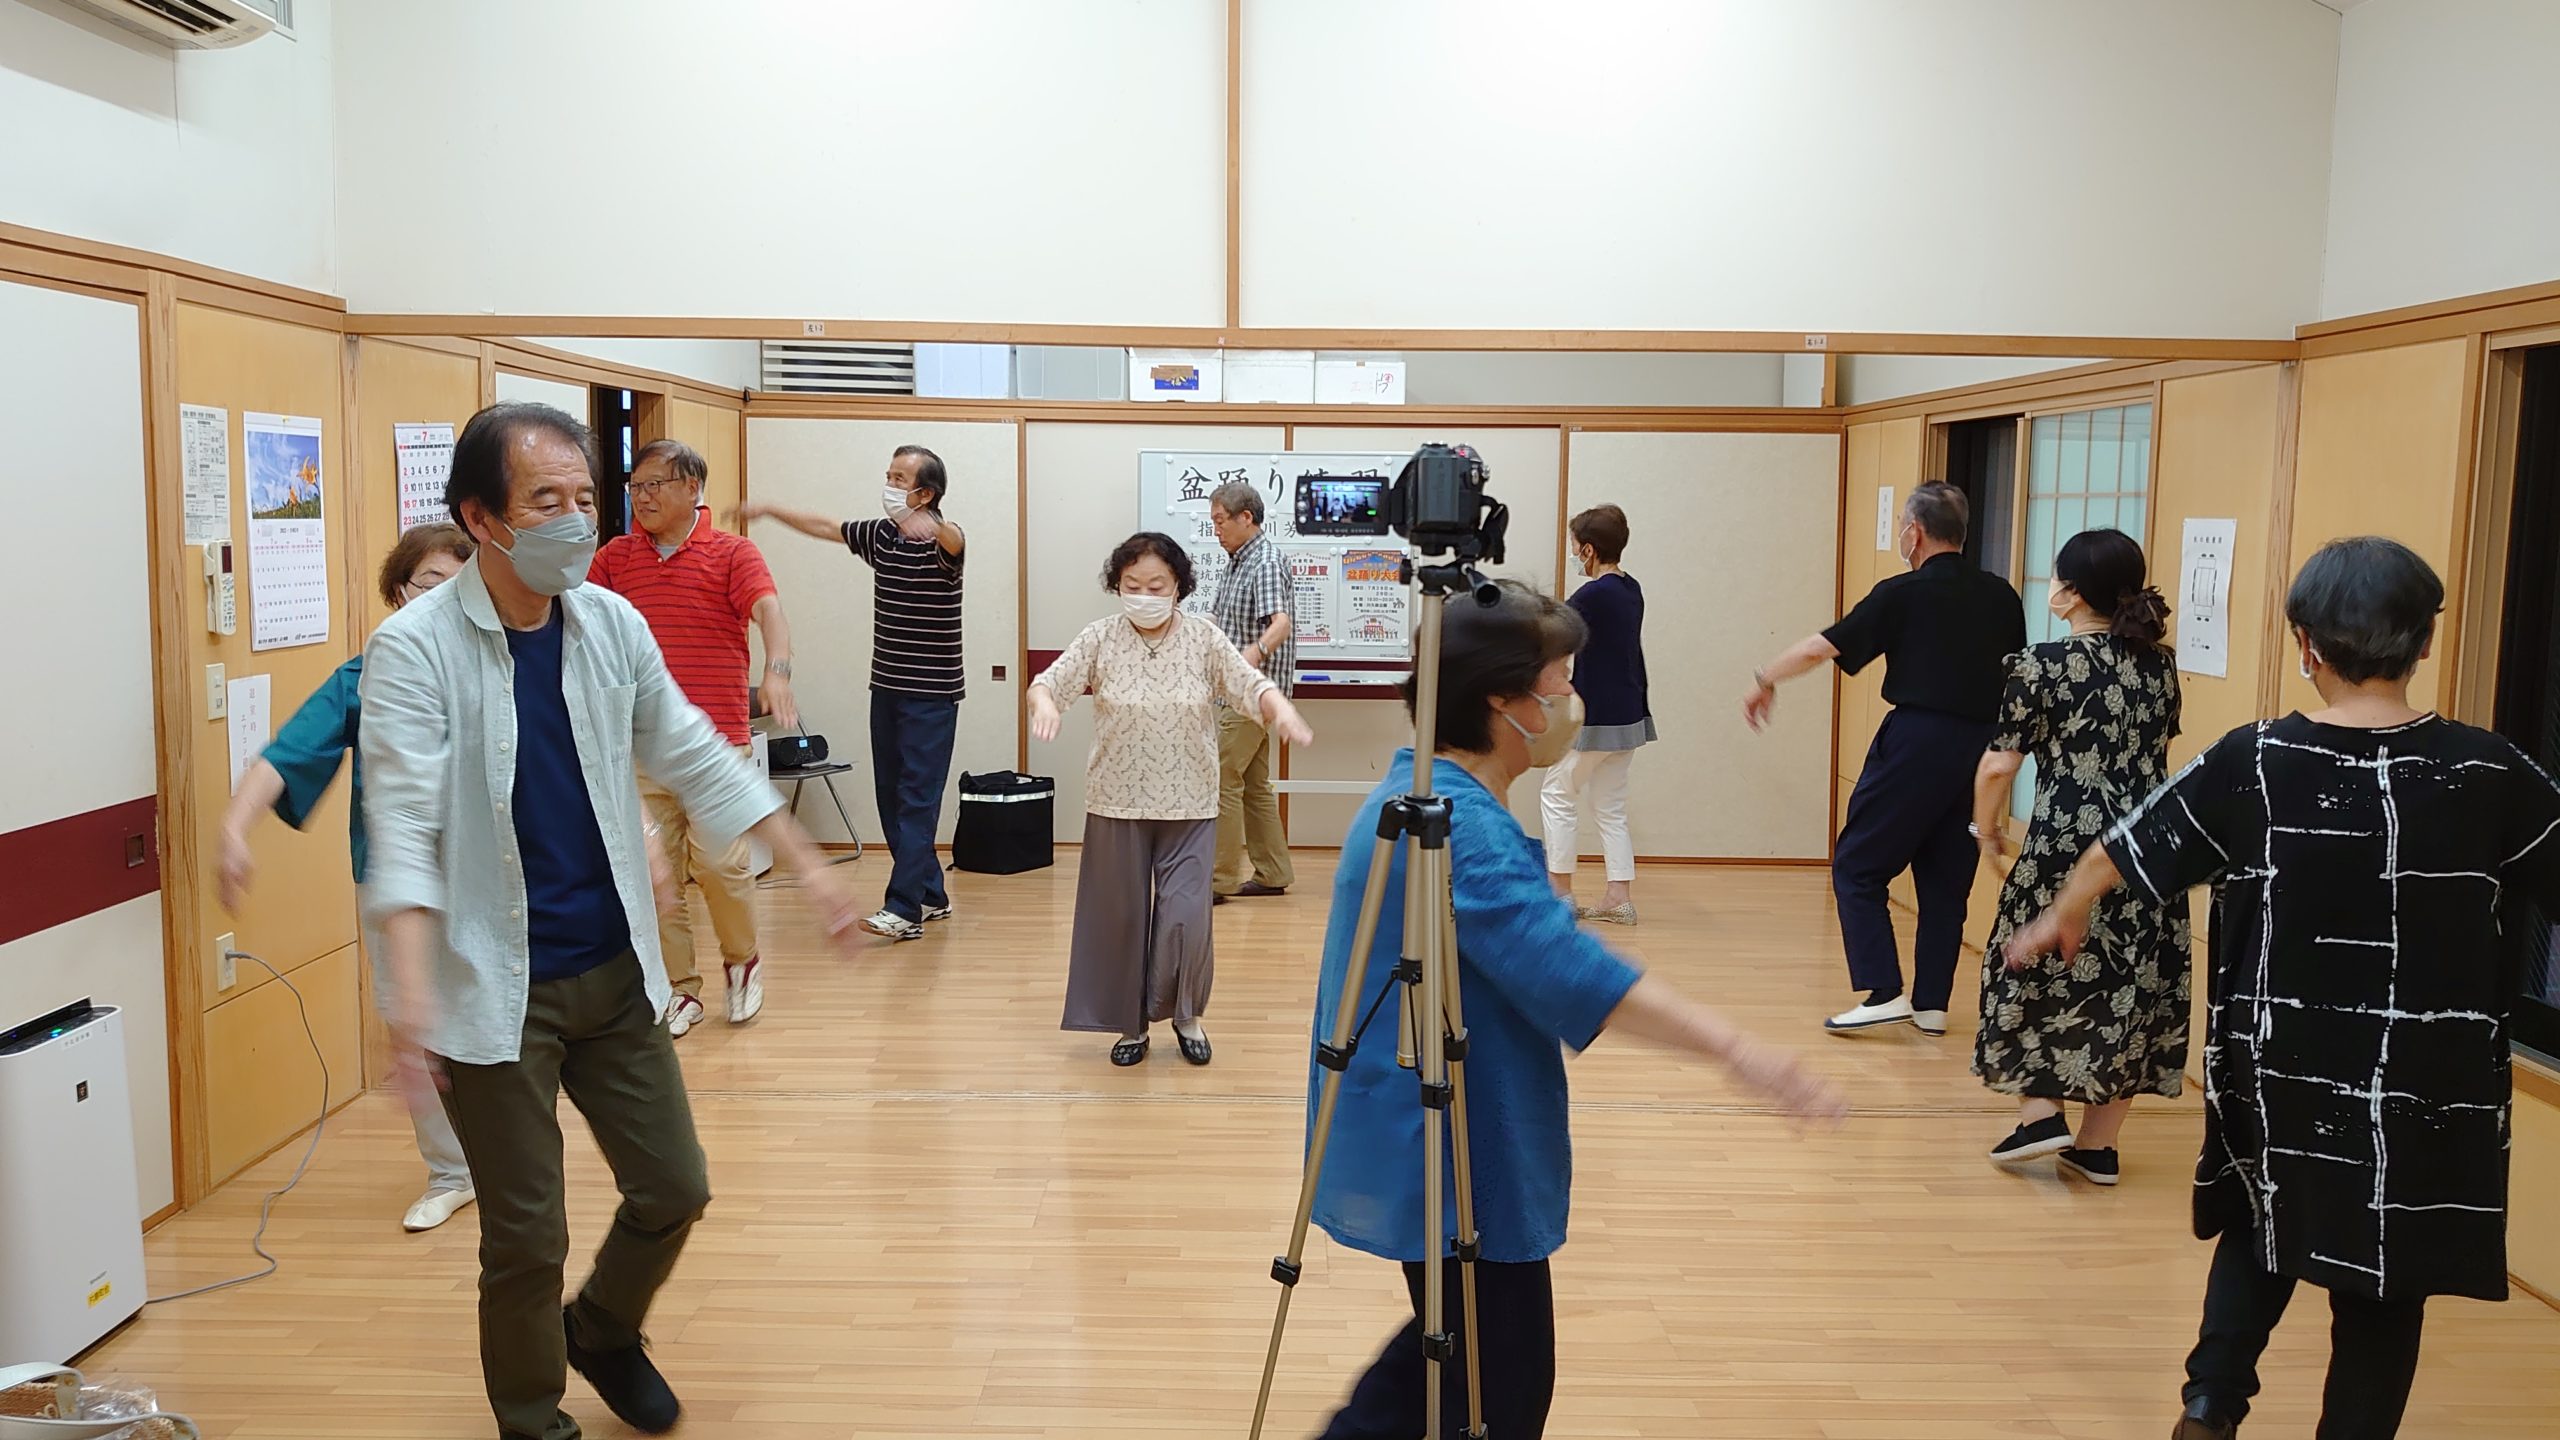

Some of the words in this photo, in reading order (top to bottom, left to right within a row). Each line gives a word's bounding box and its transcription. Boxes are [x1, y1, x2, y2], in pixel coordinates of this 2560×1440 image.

[422, 431, 428, 442] 7
[403, 467, 408, 476] 2
[411, 466, 415, 475] 3
[418, 466, 422, 475] 4
[425, 466, 429, 474] 5
[433, 466, 437, 474] 6
[441, 465, 445, 474] 7
[404, 484, 409, 492] 9
[411, 483, 416, 491] 10
[418, 482, 423, 491] 11
[425, 482, 431, 490] 12
[433, 481, 439, 490] 13
[426, 498, 432, 506] 19
[433, 497, 440, 505] 20
[403, 516, 411, 525] 23
[412, 515, 418, 524] 24
[420, 515, 426, 523] 25
[427, 514, 433, 522] 26
[434, 513, 441, 521] 27
